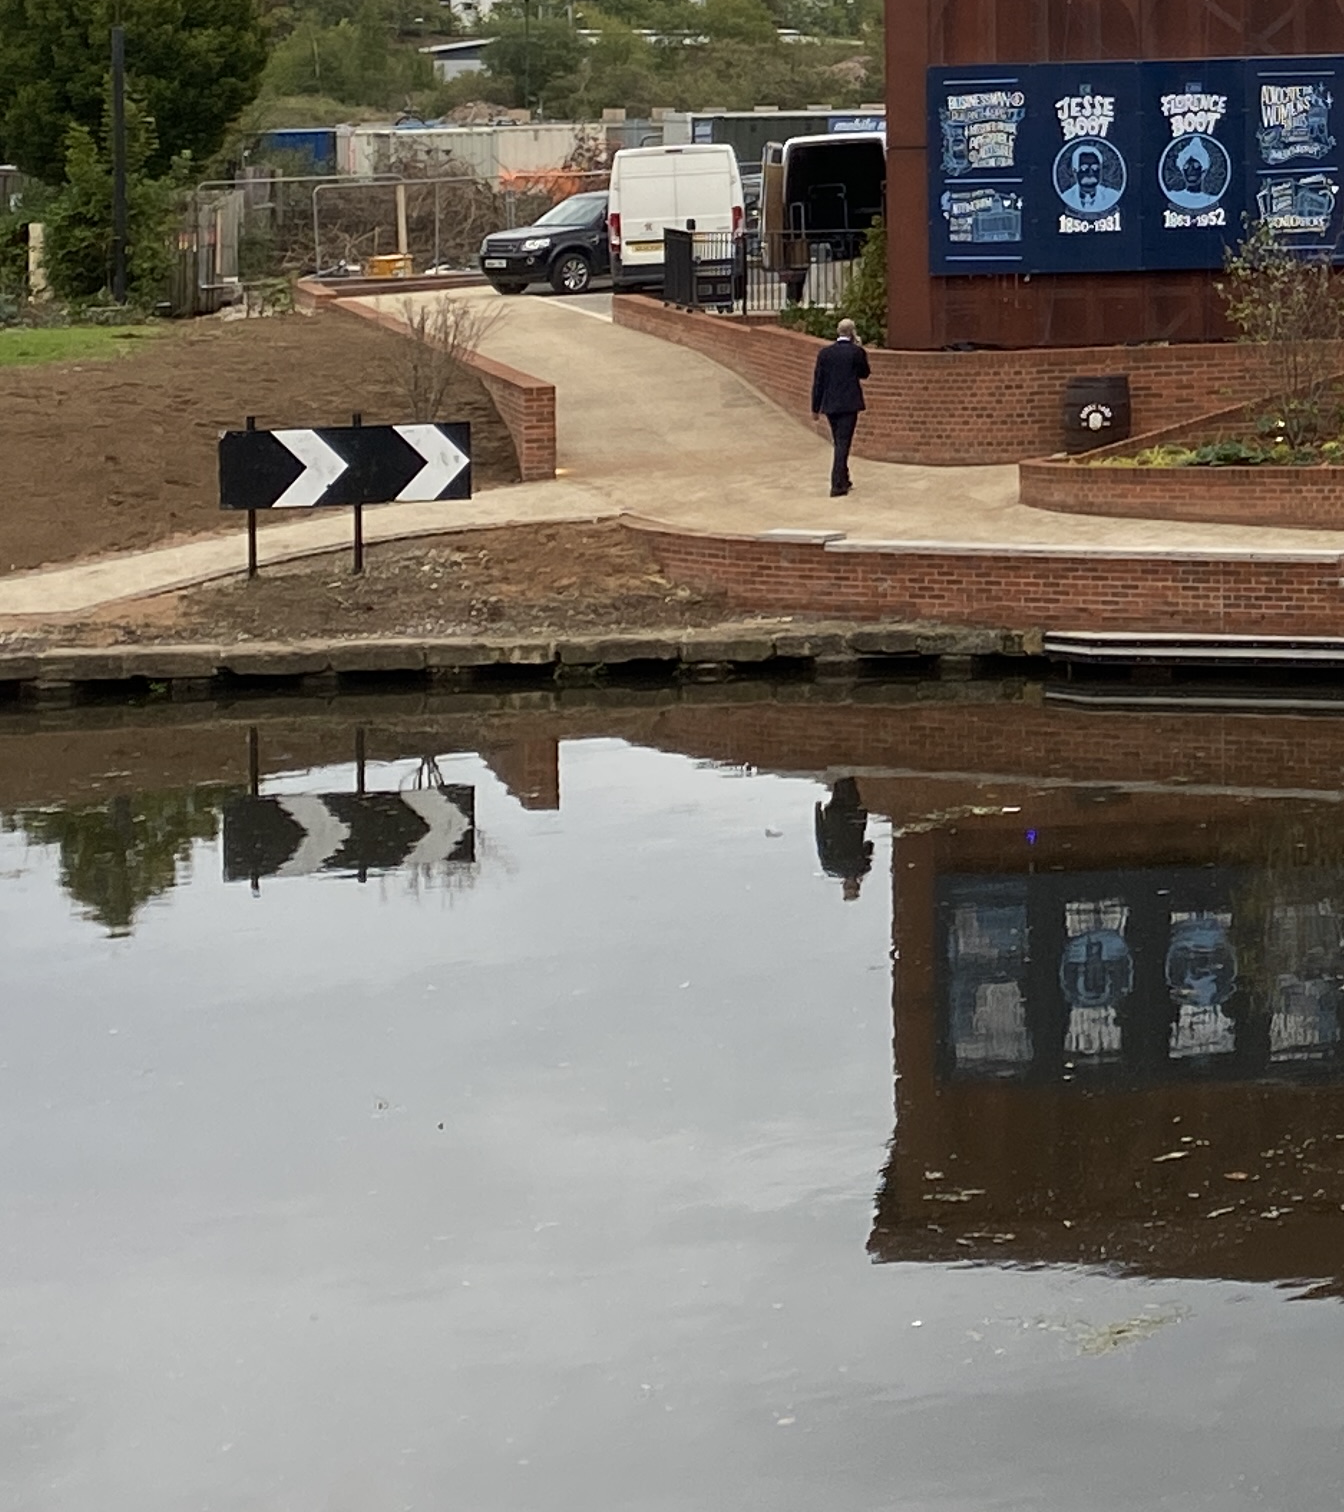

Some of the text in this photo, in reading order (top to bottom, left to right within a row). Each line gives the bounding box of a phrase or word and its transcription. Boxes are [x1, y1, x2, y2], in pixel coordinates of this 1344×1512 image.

[1055, 95, 1115, 120] JESSE
[1161, 93, 1227, 116] FLORENCE
[1061, 116, 1115, 140] BOOT
[1170, 112, 1221, 137] BOOT
[1058, 212, 1122, 234] 1850-1931
[1163, 208, 1227, 229] 1863-1952
